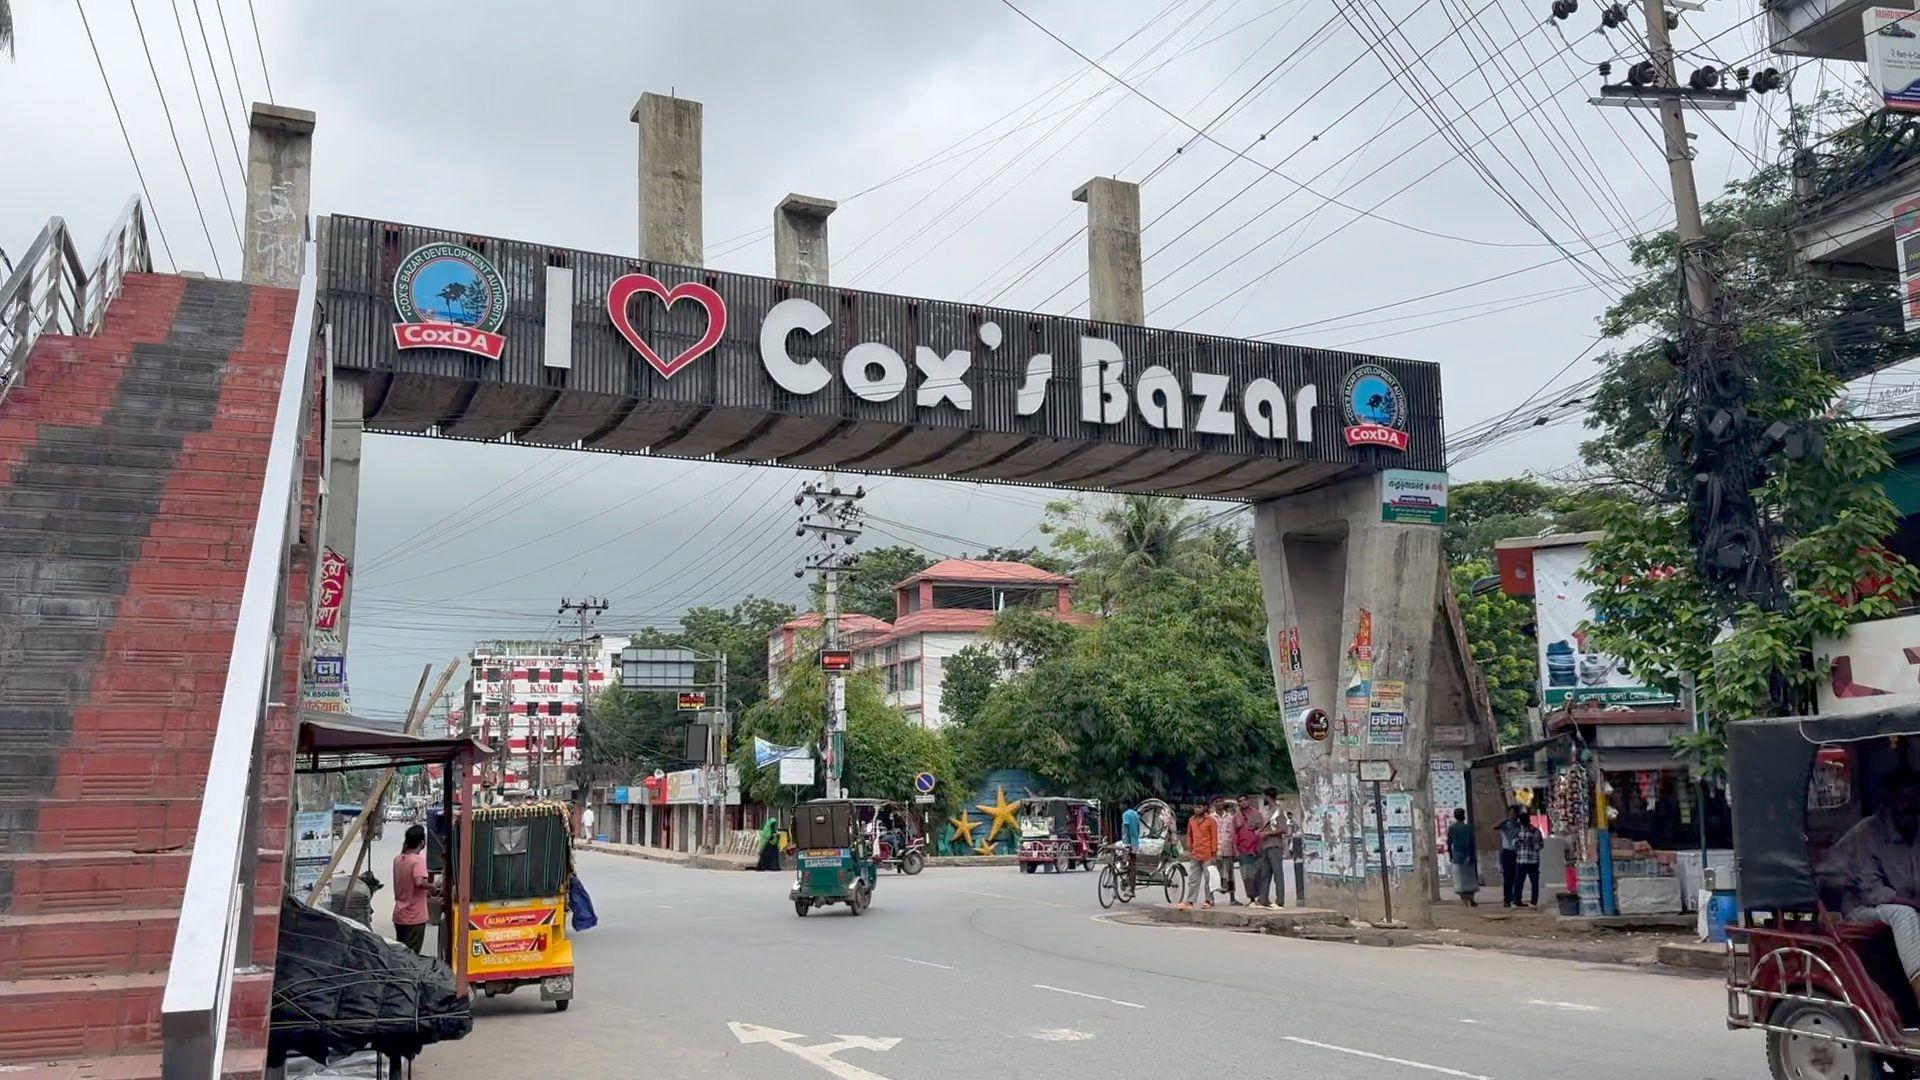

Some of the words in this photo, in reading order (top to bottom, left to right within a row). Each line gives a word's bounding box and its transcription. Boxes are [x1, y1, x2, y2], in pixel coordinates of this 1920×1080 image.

[400, 255, 426, 283] BAZAR
[422, 246, 491, 274] DEVELOPMENT
[485, 273, 503, 326] AUTHORITY
[404, 325, 489, 351] CoxDA
[544, 265, 573, 368] I
[760, 298, 1052, 416] Cox's
[1080, 335, 1317, 443] Bazar
[1345, 374, 1358, 397] BAZAR
[1355, 366, 1396, 387] DEVELOPMENT
[1393, 385, 1405, 425] AUTHORITY
[1351, 428, 1400, 445] CoxDA
[530, 683, 559, 694] KSRM
